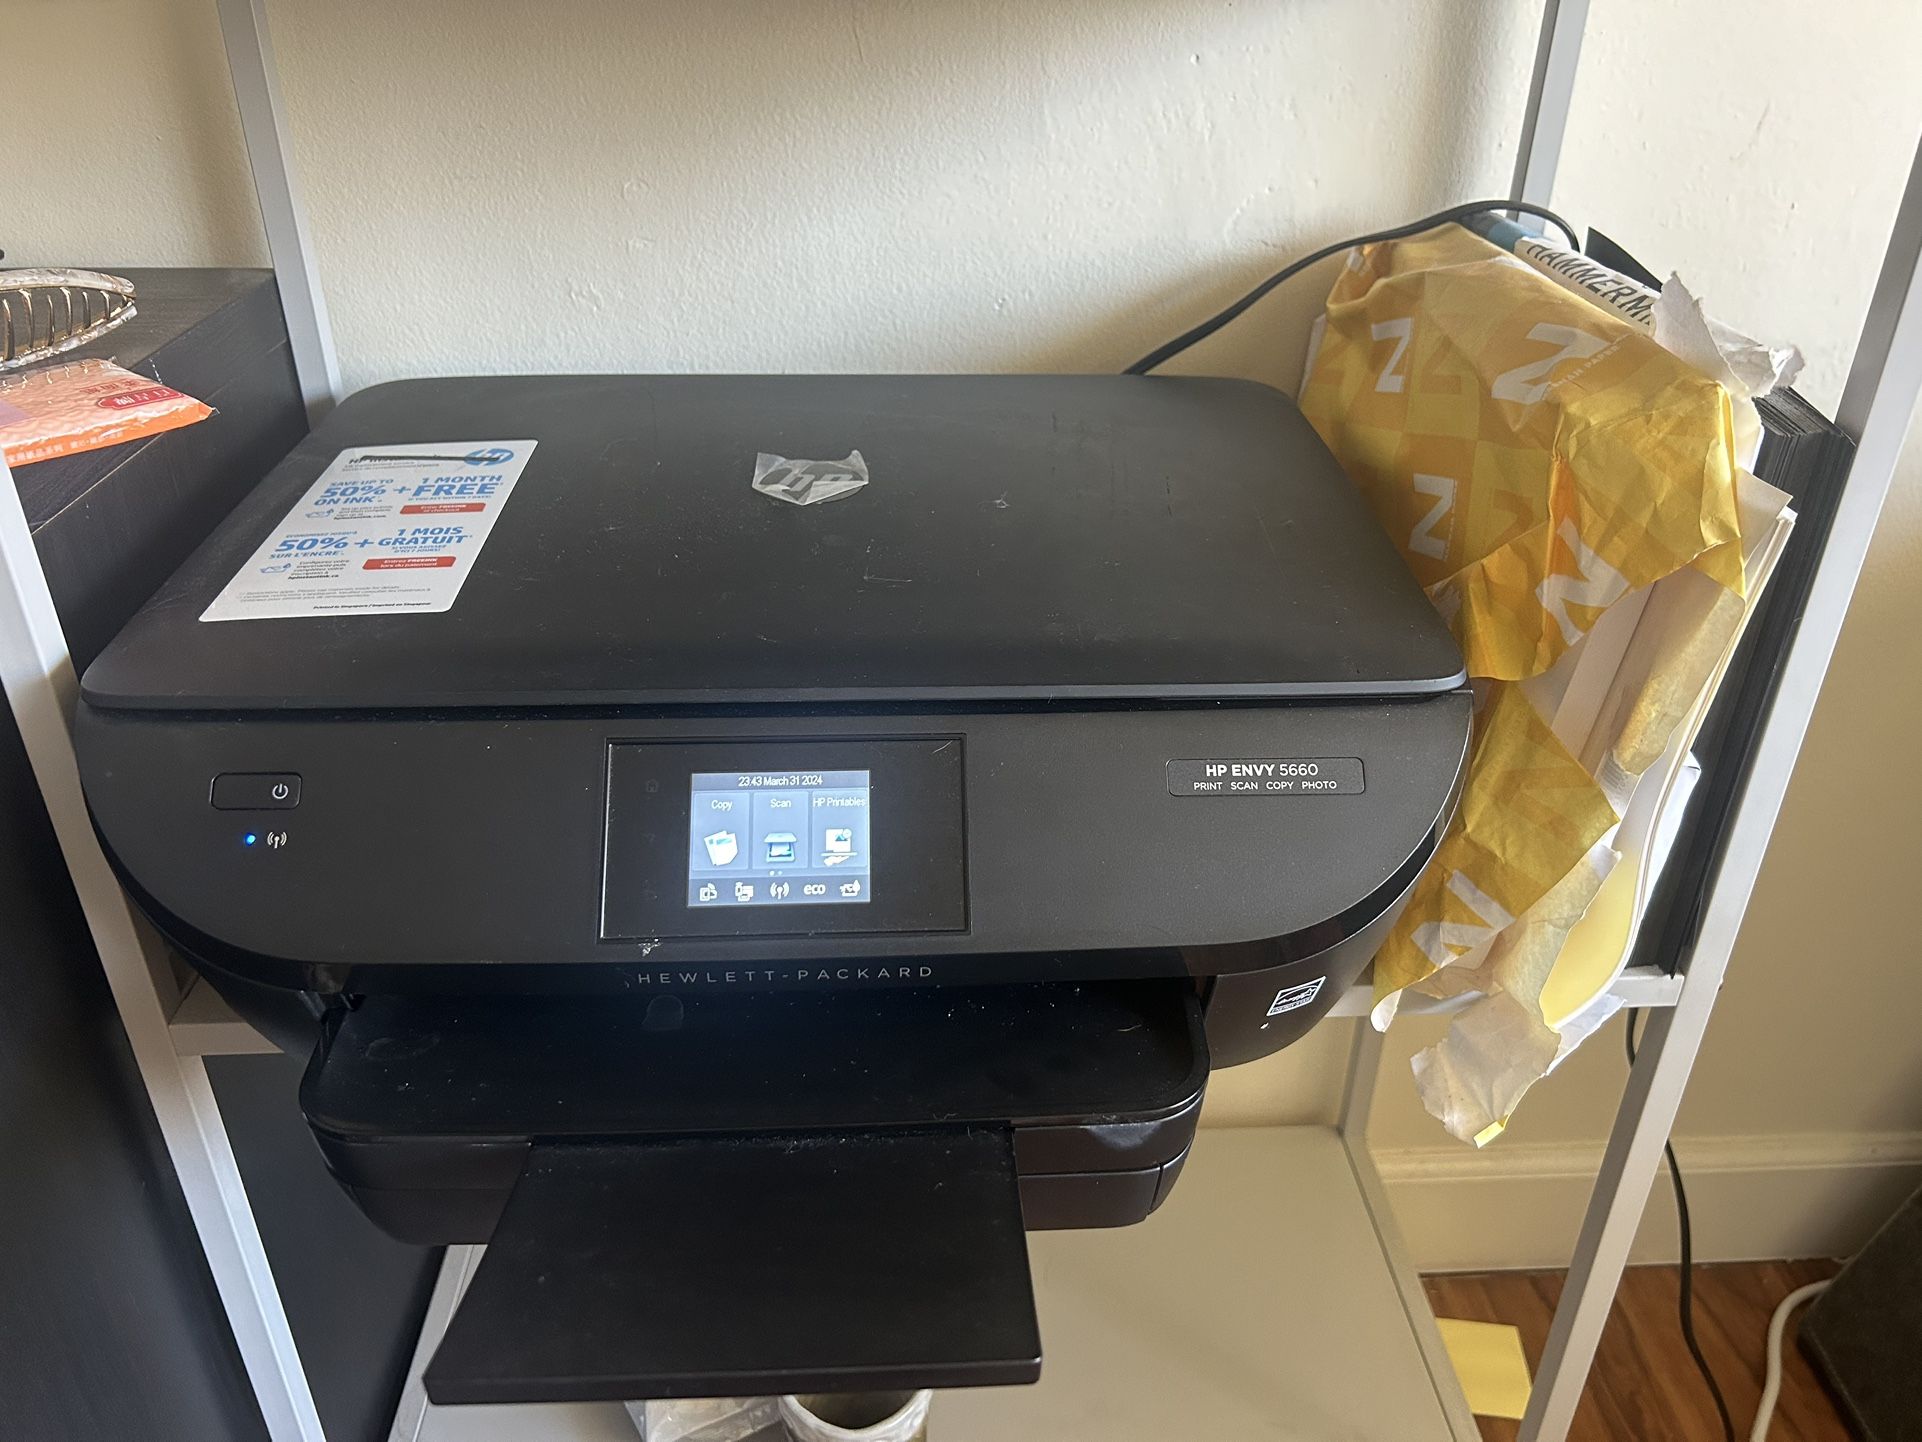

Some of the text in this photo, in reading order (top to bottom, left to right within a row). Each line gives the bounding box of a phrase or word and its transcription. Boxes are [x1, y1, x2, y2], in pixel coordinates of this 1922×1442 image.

[434, 475, 503, 484] MONTH
[319, 484, 387, 498] 50%
[313, 498, 342, 506] ON
[397, 526, 464, 536] 1 MOIS
[275, 536, 349, 552] 50%
[1206, 763, 1319, 777] HP ENVY 5660
[763, 775, 789, 786] March
[790, 775, 800, 785] 31
[801, 775, 823, 786] 2024
[1193, 780, 1338, 791] PRINT SCAN COPY PHOTO
[711, 800, 733, 811] Copy
[770, 798, 792, 808] Scan
[812, 796, 866, 808] HP Printables
[803, 883, 826, 895] eco
[637, 965, 933, 985] HEWLETT-PACKARD
